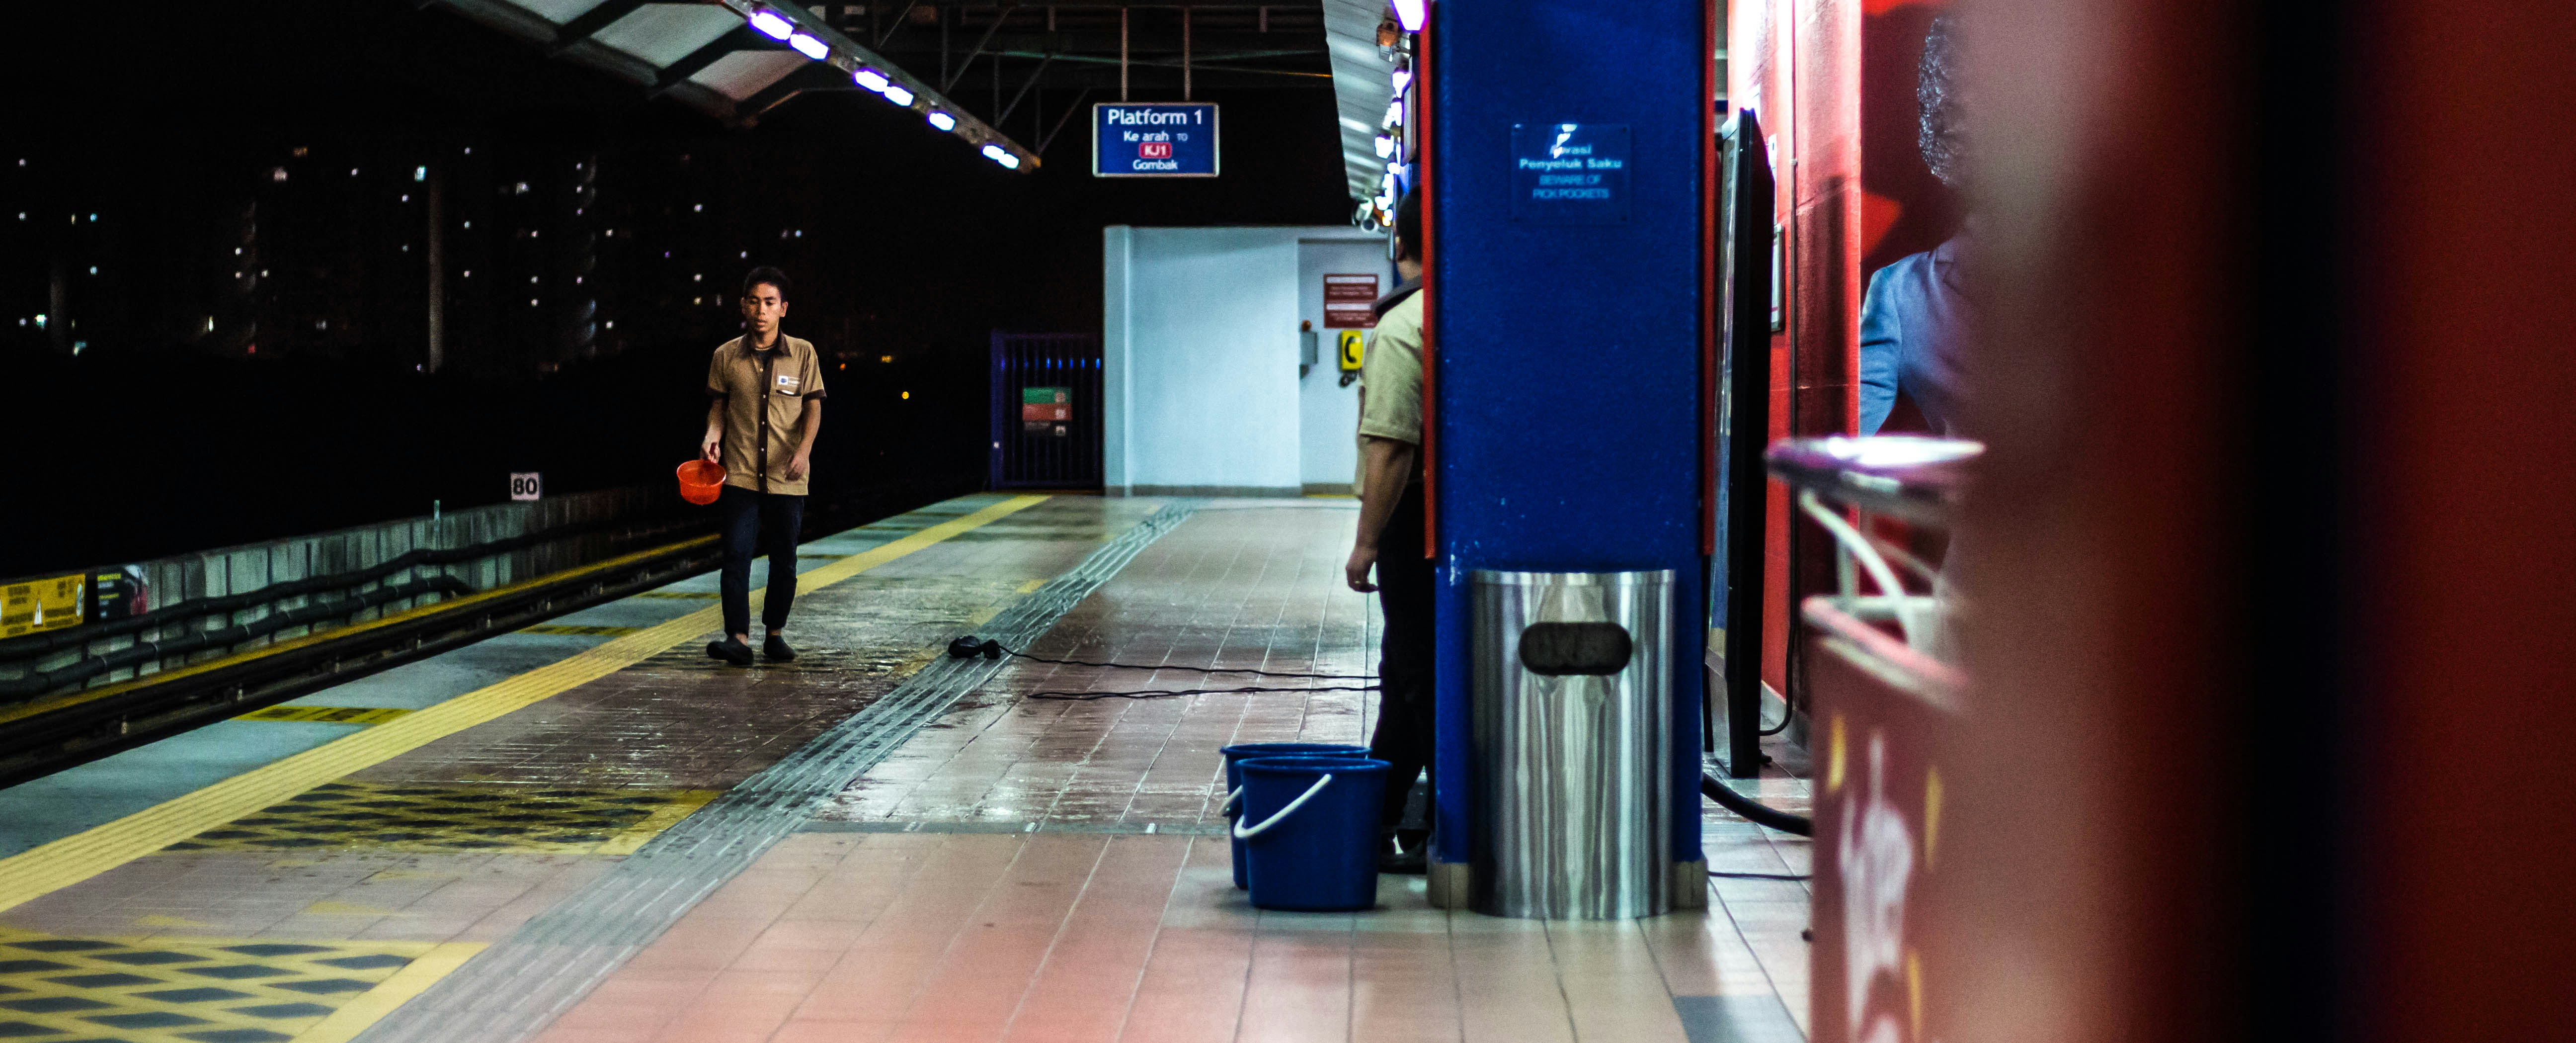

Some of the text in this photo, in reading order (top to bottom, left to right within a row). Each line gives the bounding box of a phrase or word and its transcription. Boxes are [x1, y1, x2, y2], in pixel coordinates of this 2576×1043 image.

[1108, 108, 1202, 125] Platform 1
[1124, 131, 1139, 142] Ke
[1142, 130, 1169, 142] arah
[1144, 146, 1166, 156] KJ1
[1132, 160, 1178, 170] Gombak
[1519, 158, 1622, 171] Penyeluk Saku
[1539, 174, 1602, 185] BEWARE OF
[513, 477, 537, 495] 80
